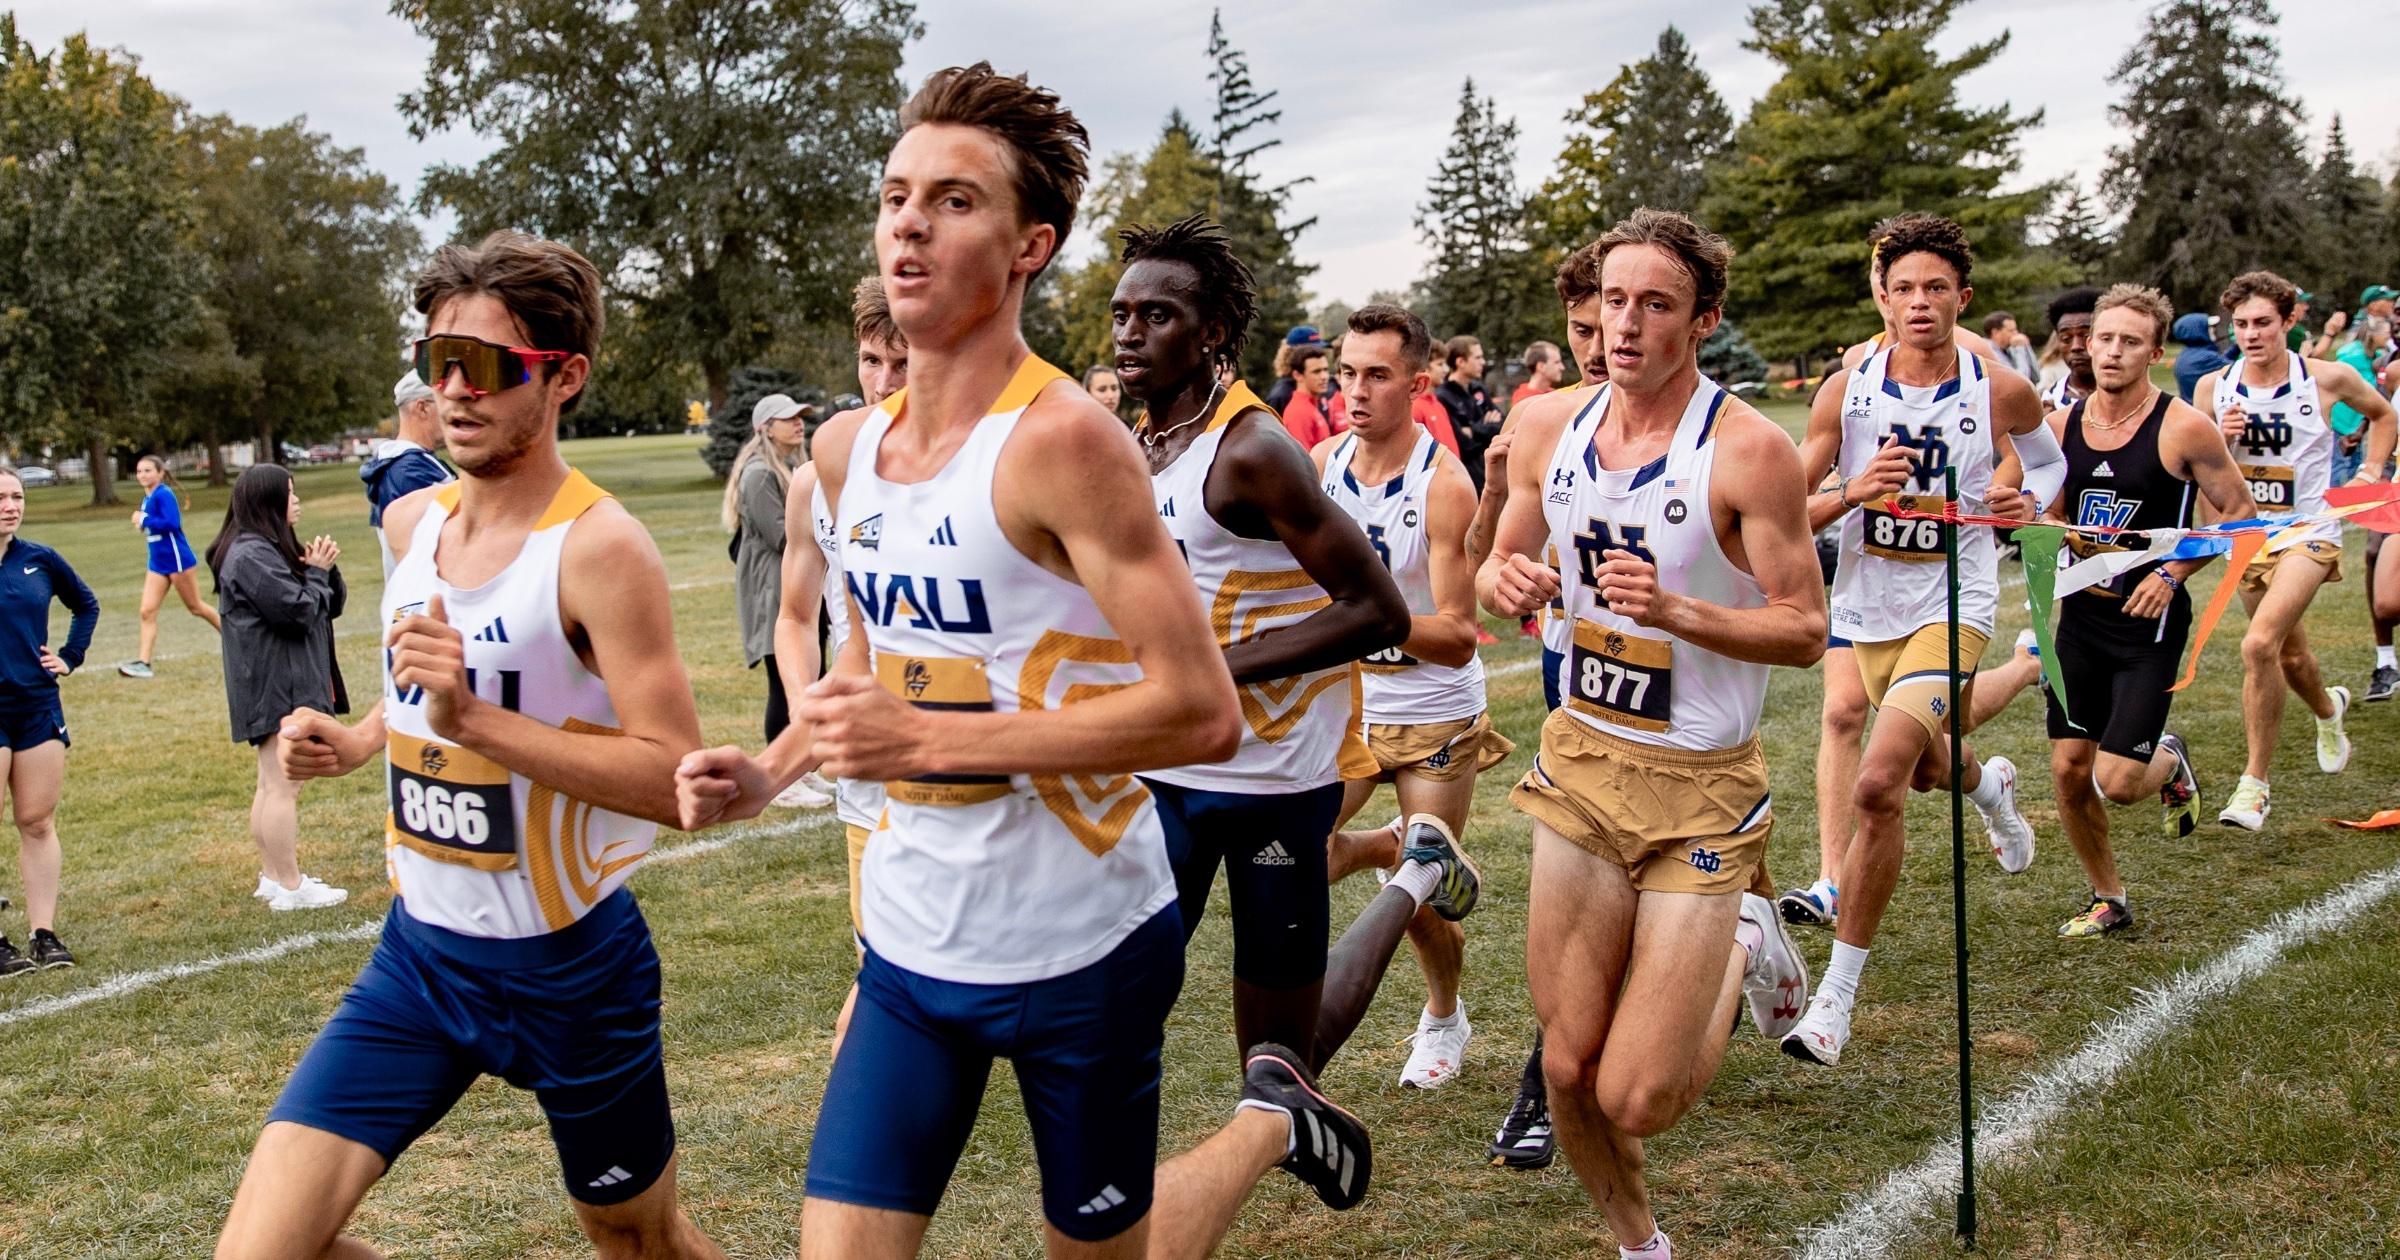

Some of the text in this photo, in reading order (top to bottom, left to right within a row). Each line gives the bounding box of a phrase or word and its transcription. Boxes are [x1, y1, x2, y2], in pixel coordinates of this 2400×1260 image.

[1549, 491, 1573, 503] ACC
[1669, 506, 1685, 517] AB
[1874, 515, 1939, 550] 876
[845, 570, 993, 634] NAU
[1581, 656, 1651, 711] 877
[1591, 709, 1614, 721] NOTRE
[1616, 716, 1638, 728] DAME
[400, 777, 490, 845] 866
[1252, 855, 1296, 865] adidas
